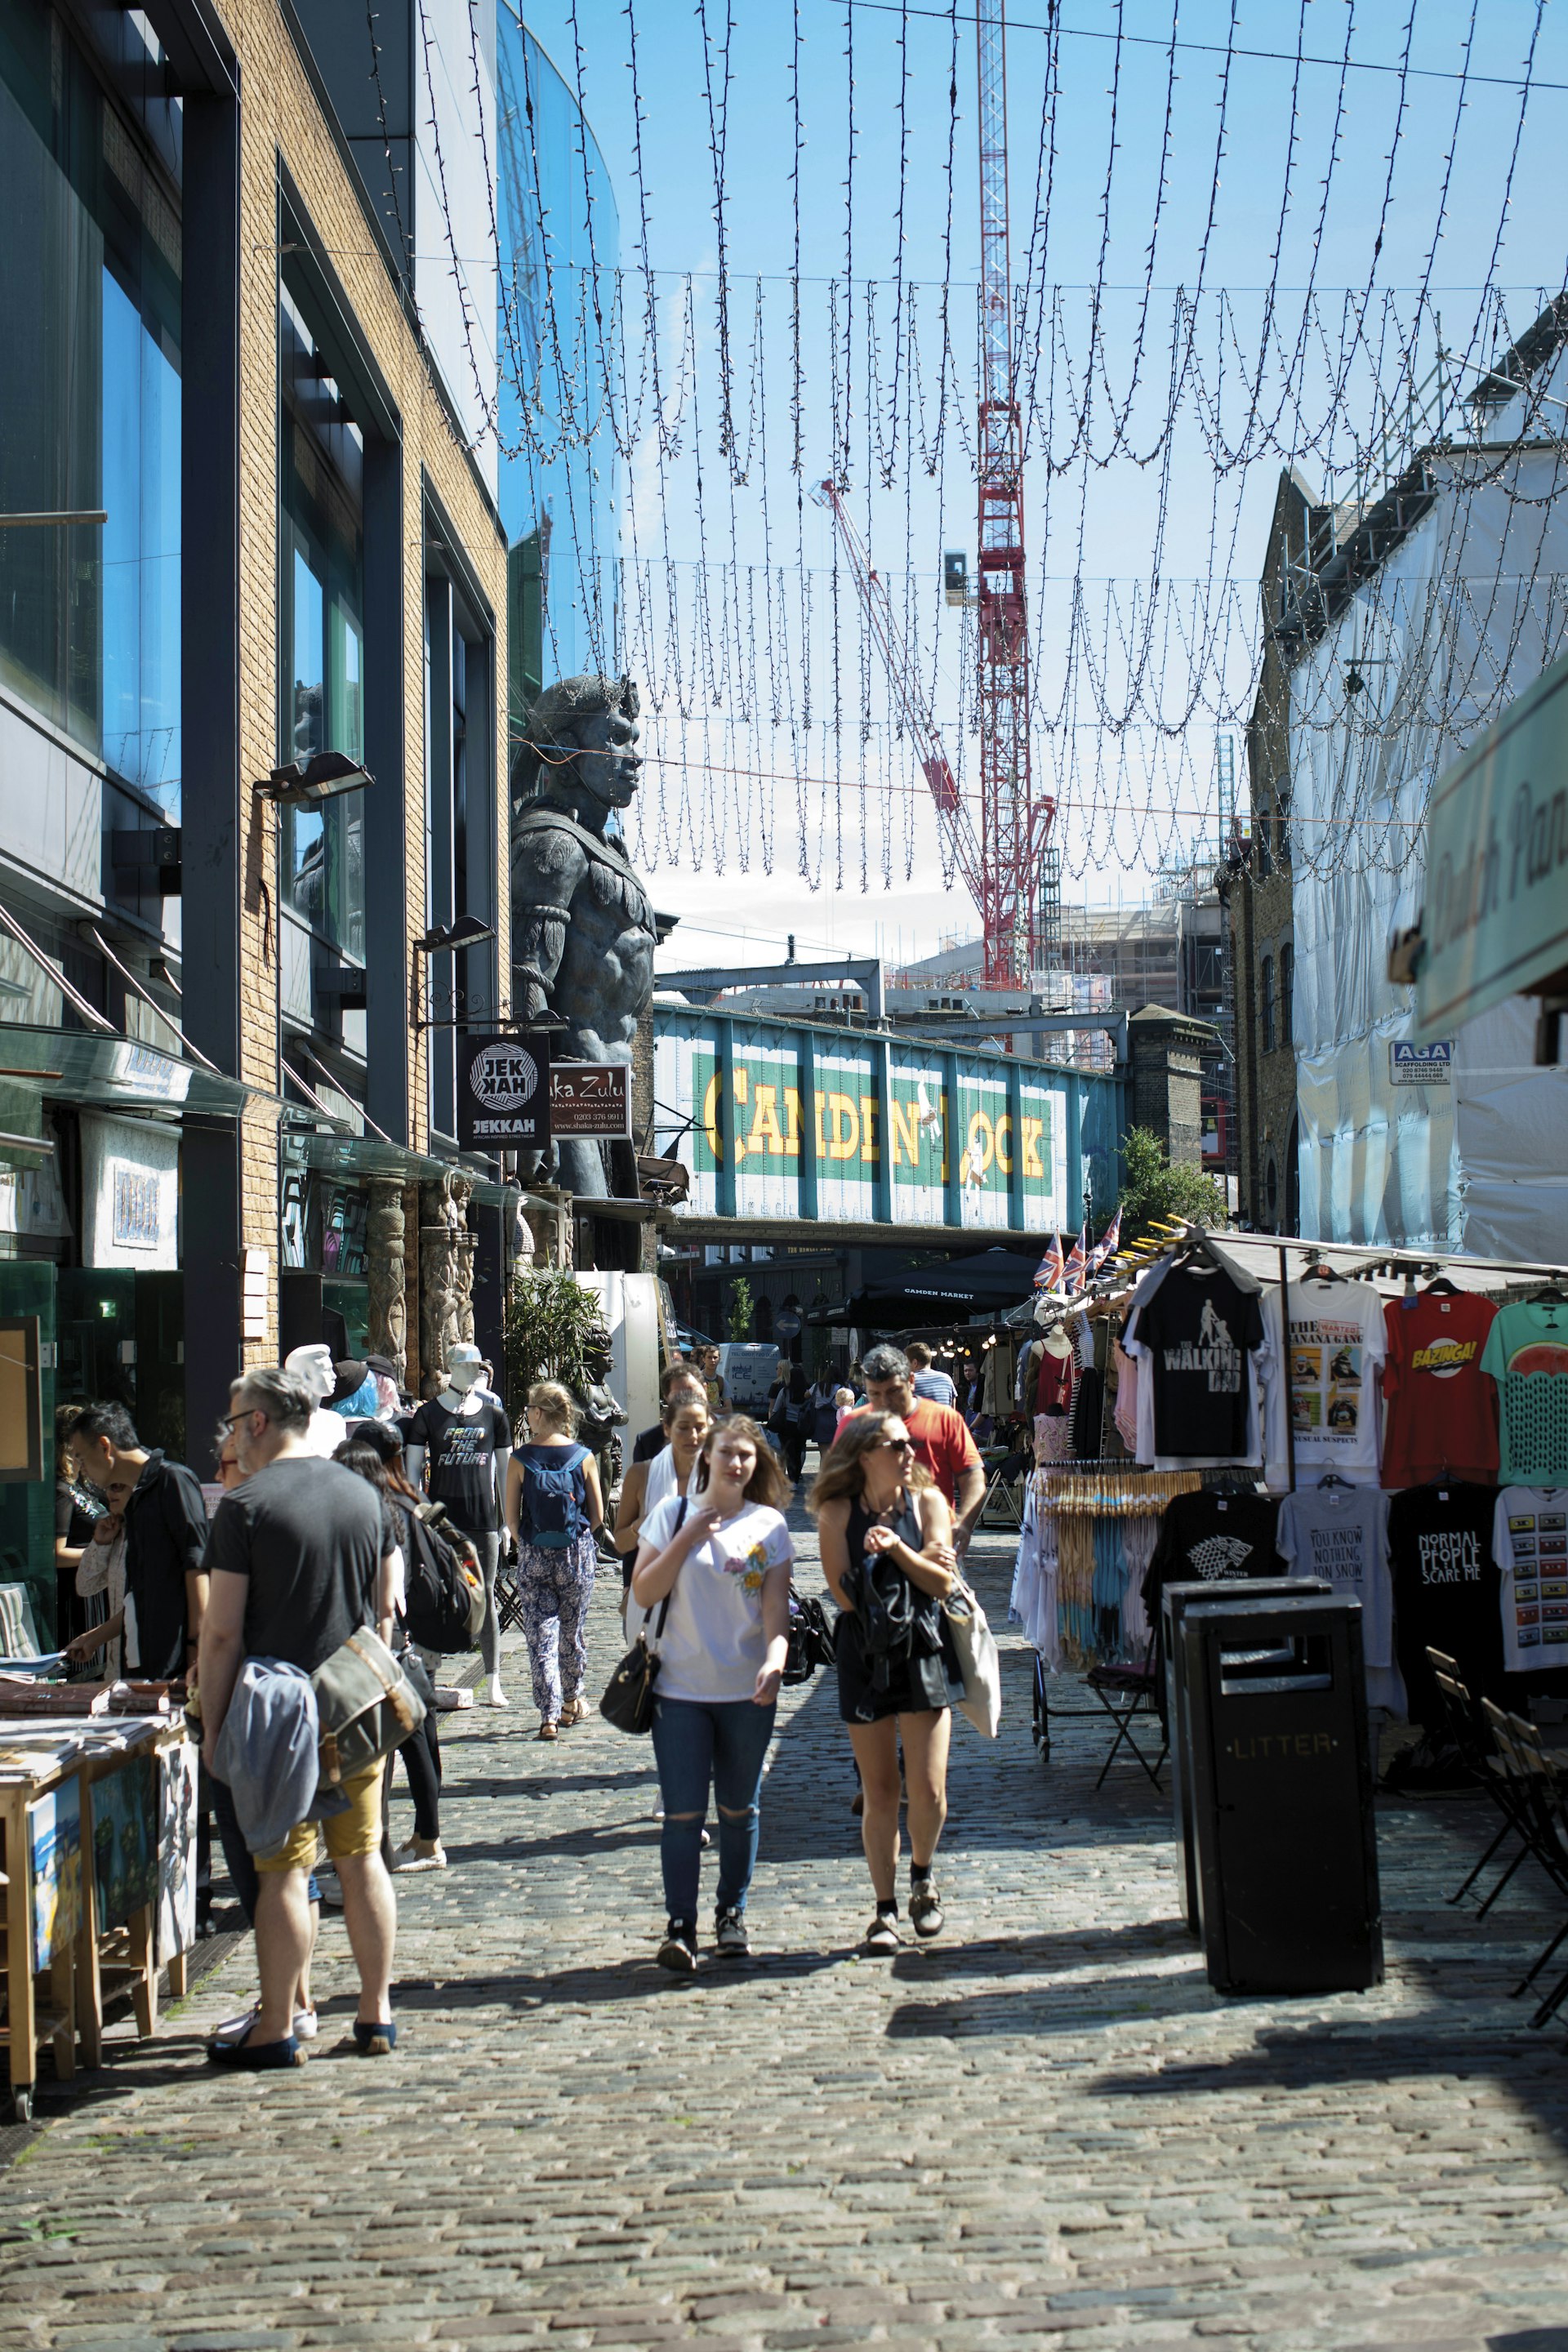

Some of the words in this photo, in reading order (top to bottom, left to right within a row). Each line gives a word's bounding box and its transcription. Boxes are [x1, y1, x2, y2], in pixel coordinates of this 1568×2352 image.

[1397, 1045, 1447, 1059] AGA
[485, 1058, 524, 1077] JEK
[579, 1071, 625, 1098] Zulu
[554, 1121, 625, 1129] www.shaka-zulu.com
[703, 1067, 920, 1167] CAMDEN
[472, 1119, 535, 1134] JEKKAH
[904, 1288, 938, 1296] CAMDEN
[940, 1291, 974, 1299] MARKET
[1290, 1320, 1318, 1334] THE
[1321, 1324, 1356, 1334] WANTED
[1180, 1340, 1192, 1349] THE
[1334, 1334, 1364, 1344] GANG
[1163, 1348, 1241, 1371] WALKING
[1411, 1340, 1477, 1370] BAZINGA!
[443, 1427, 486, 1441] FROM
[1322, 1437, 1358, 1445] SUSPECTS
[450, 1440, 478, 1453] THE
[438, 1452, 489, 1467] FUTURE
[1310, 1533, 1330, 1548] YOU
[1332, 1529, 1363, 1547] KNOW
[1418, 1530, 1481, 1551] NORMAL
[1314, 1546, 1361, 1565] NOTHING
[1421, 1546, 1481, 1571] PEOPLE
[1335, 1561, 1364, 1579] SNOW
[1422, 1568, 1461, 1584] SCARE
[1464, 1567, 1481, 1581] ME
[1234, 1731, 1332, 1761] LITTER
